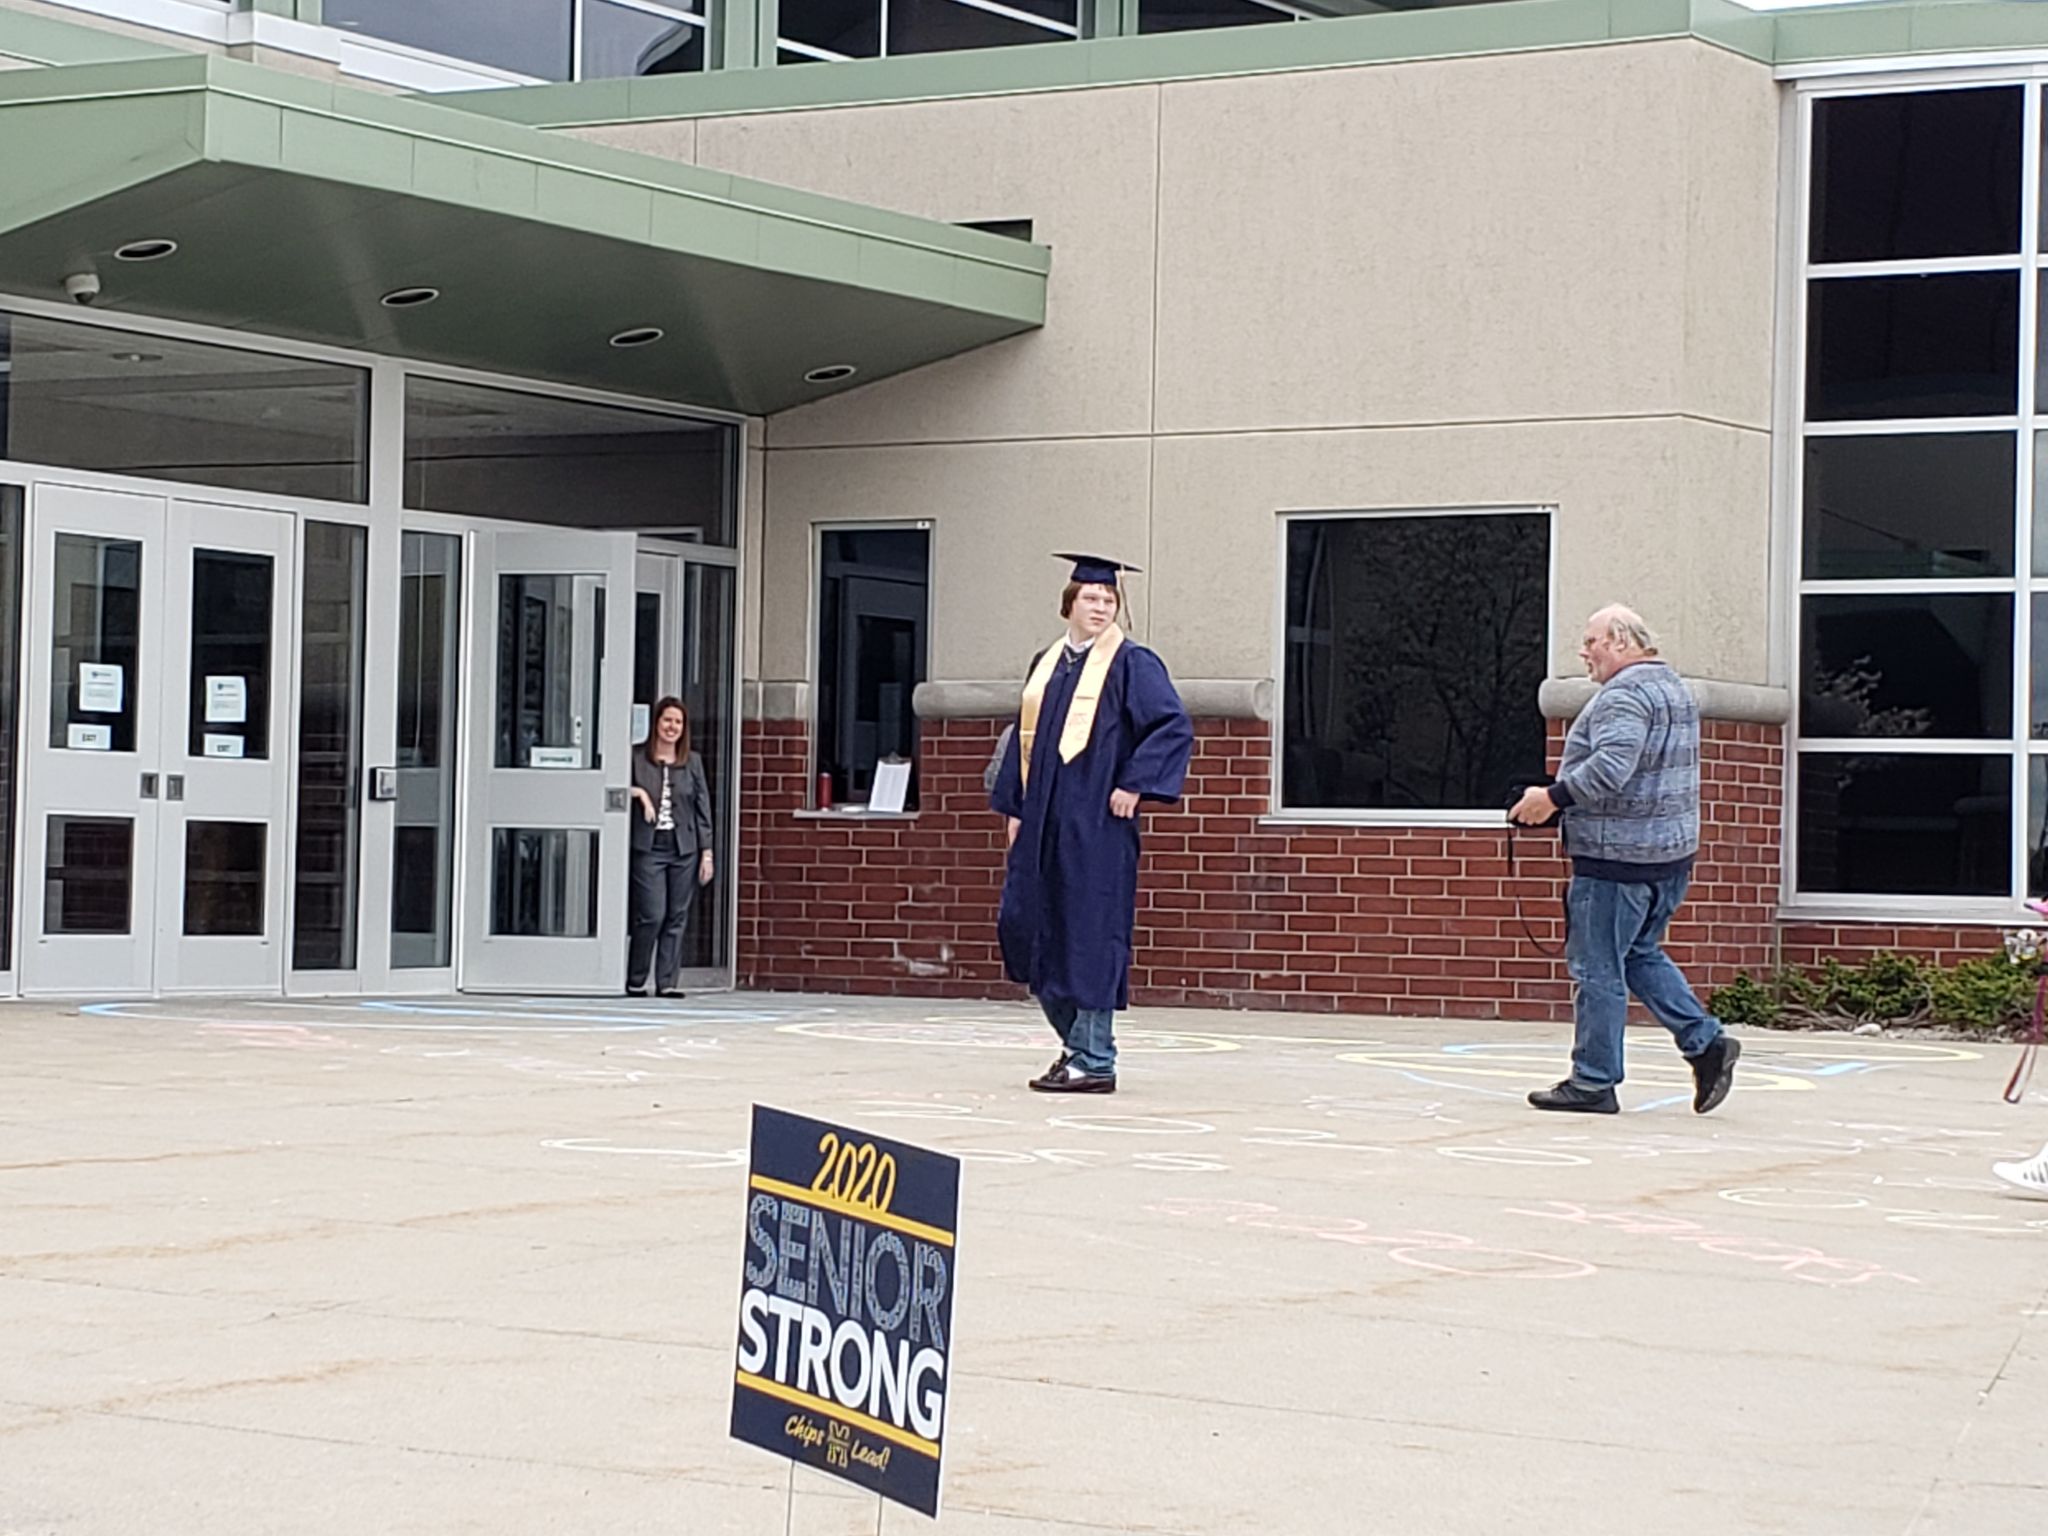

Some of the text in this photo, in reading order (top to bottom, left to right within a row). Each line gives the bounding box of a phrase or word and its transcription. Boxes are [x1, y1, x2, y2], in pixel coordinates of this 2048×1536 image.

[810, 1132, 896, 1213] 2020
[746, 1194, 948, 1350] SENIOR
[738, 1289, 944, 1440] STRONG
